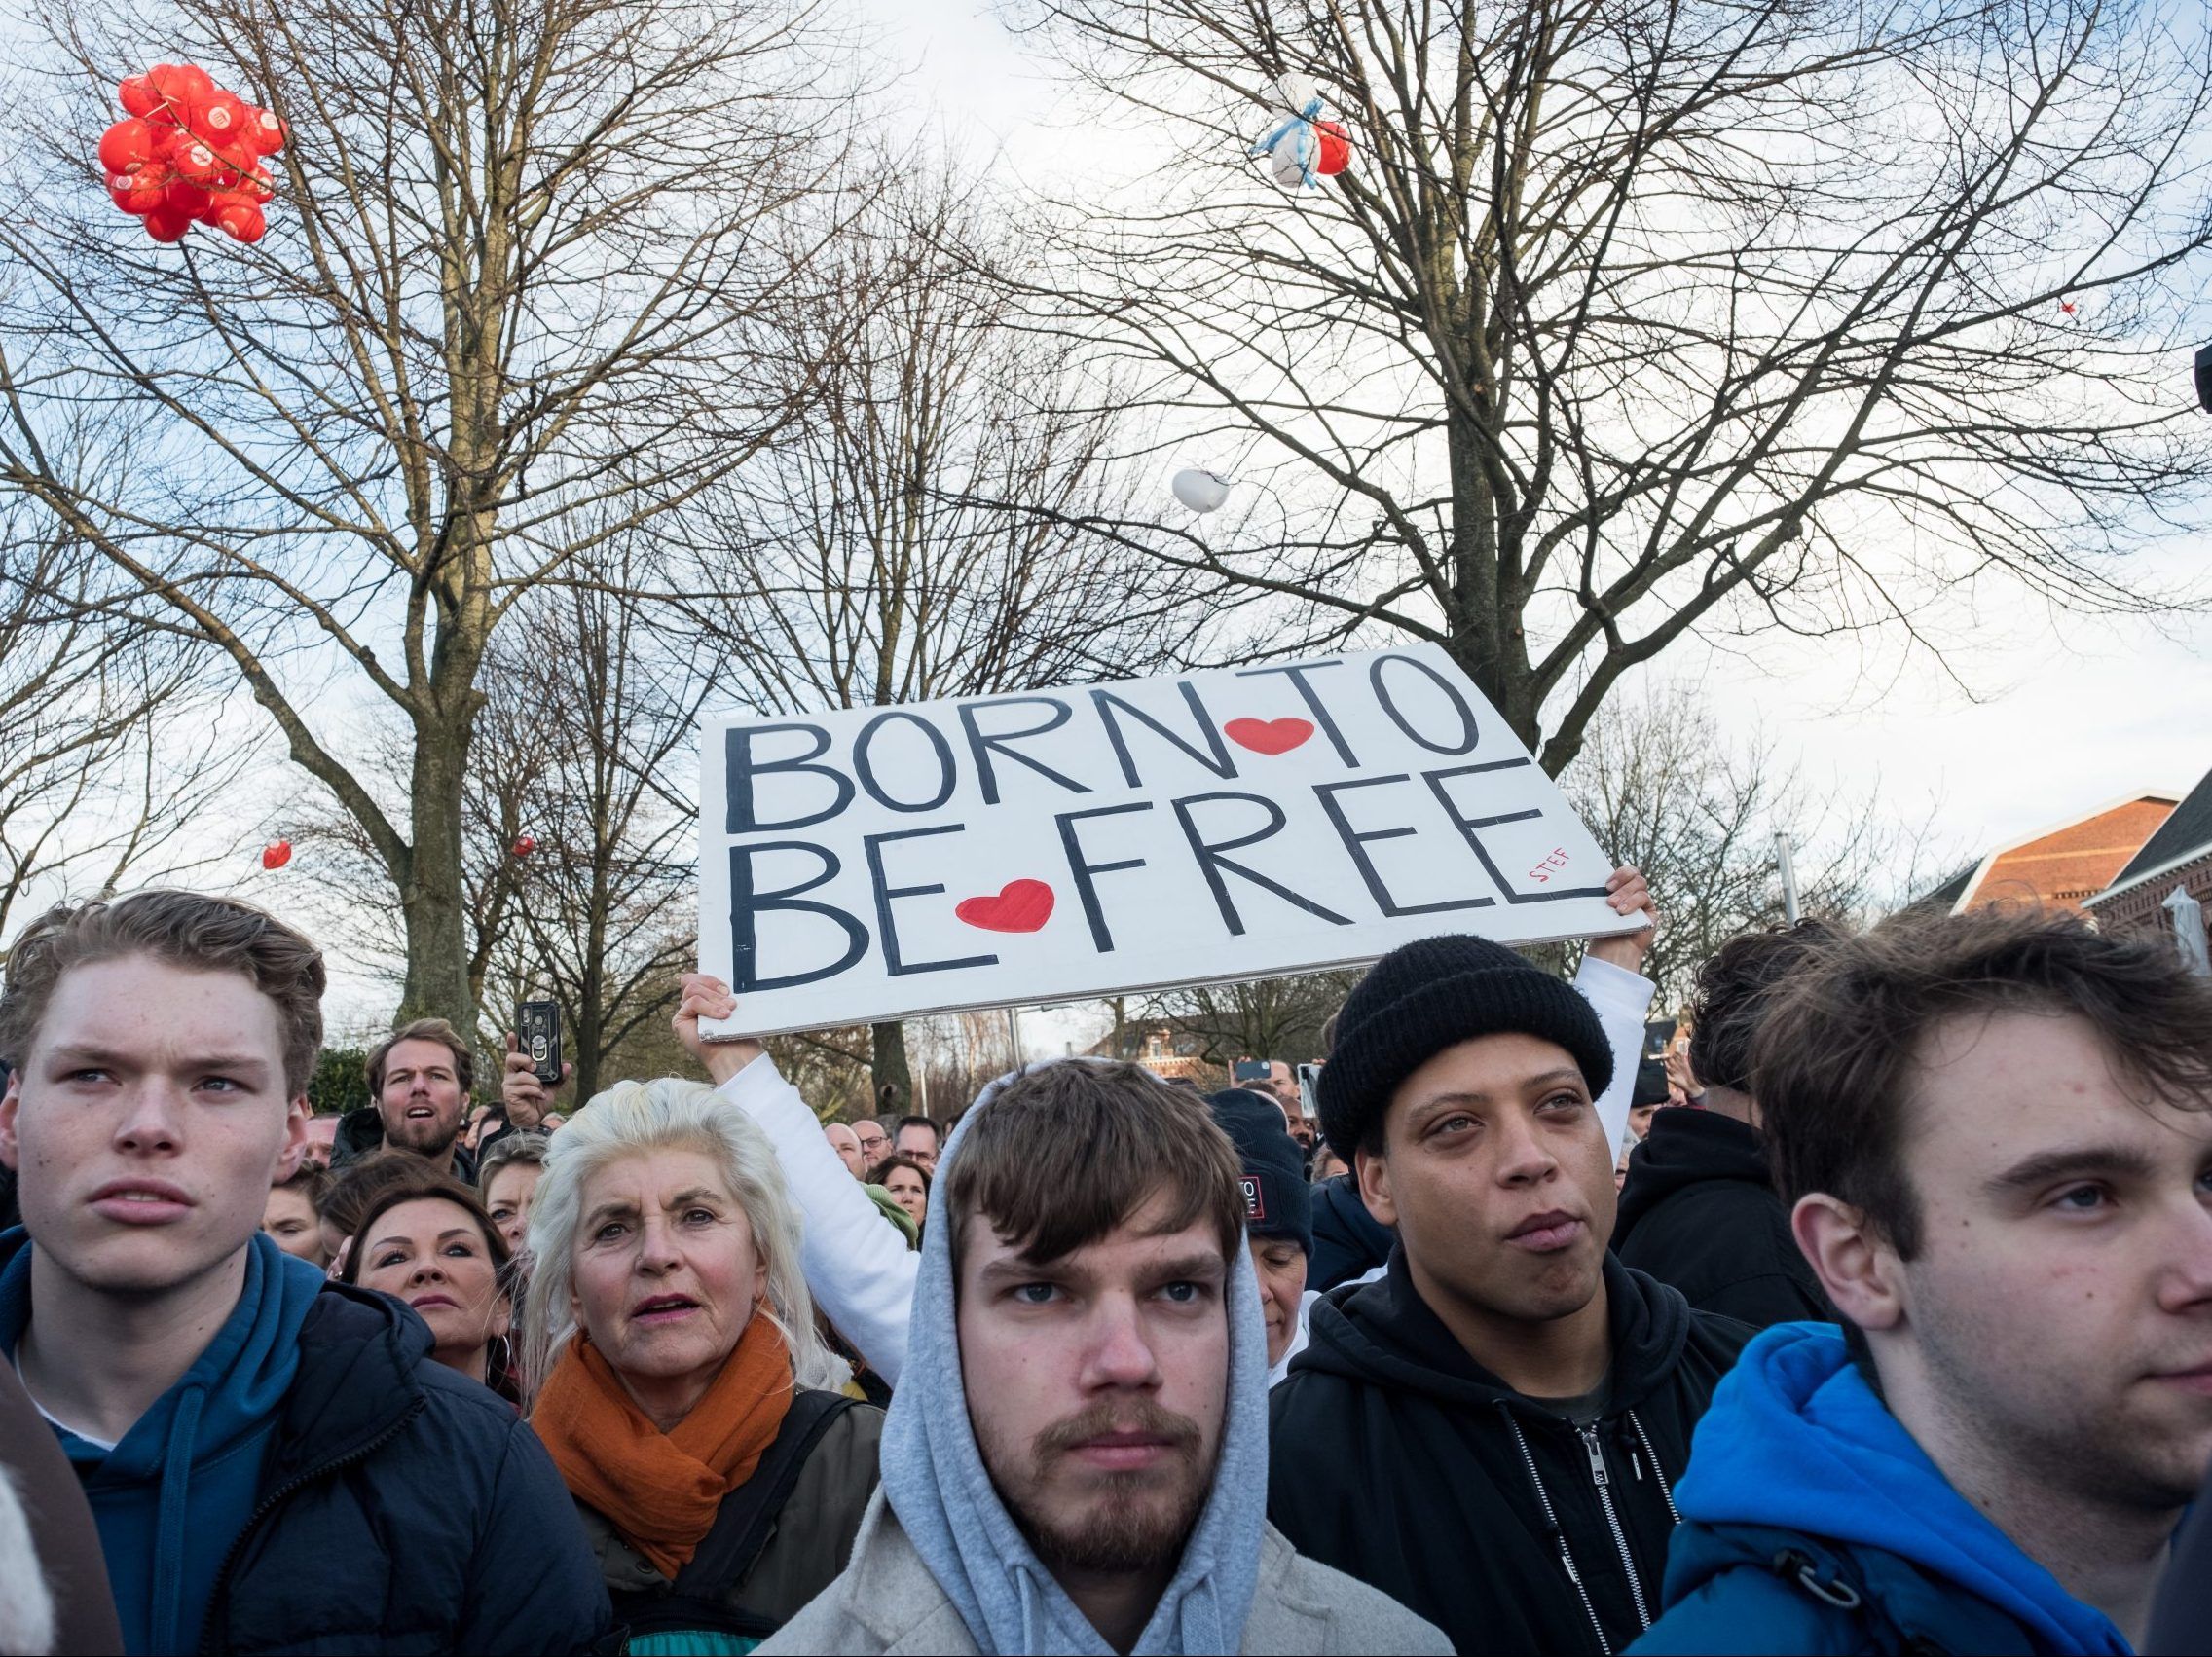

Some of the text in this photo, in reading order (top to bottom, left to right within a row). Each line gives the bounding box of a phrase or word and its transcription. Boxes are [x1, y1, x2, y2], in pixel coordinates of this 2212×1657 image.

[726, 655, 1480, 834] BORN TO
[726, 757, 1611, 995] BE FREE
[1529, 847, 1570, 883] STEF
